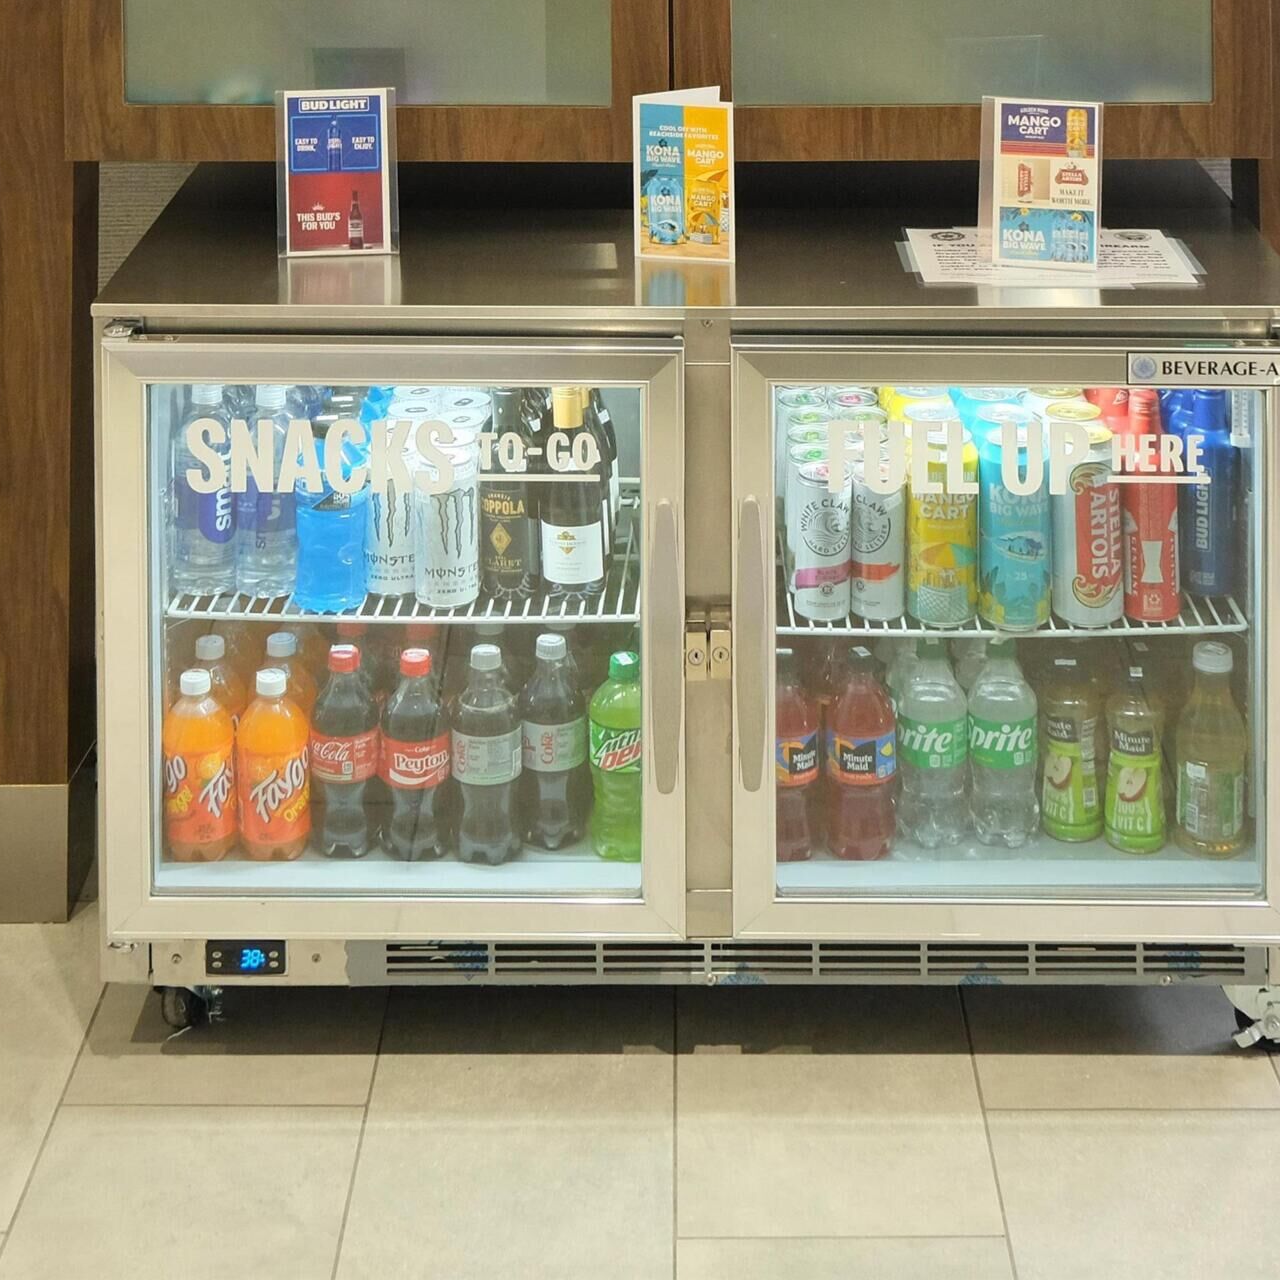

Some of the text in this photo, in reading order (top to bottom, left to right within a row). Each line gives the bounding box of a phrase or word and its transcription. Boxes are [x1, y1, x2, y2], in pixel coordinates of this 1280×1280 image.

[301, 99, 367, 111] BUD LIGHT
[1007, 114, 1062, 128] MANGO
[1019, 126, 1049, 136] CART
[687, 149, 725, 160] MANGO
[296, 213, 315, 222] THIS
[302, 221, 336, 231] FOR YOU
[1002, 229, 1046, 243] KONA
[185, 417, 601, 495] SNACKS TO-GO
[827, 419, 1206, 496] FUEL UP HERE
[855, 494, 888, 517] CLAW
[921, 504, 970, 520] CART
[800, 501, 820, 532] WHITE
[1090, 491, 1108, 580] ARTOIS
[1108, 487, 1122, 577] STELLA
[1196, 519, 1209, 550] BUD
[364, 553, 415, 566] MONSTE
[393, 750, 449, 775] Peyton
[843, 751, 873, 763] Minute
[847, 761, 869, 771] Maid
[249, 745, 309, 823] Faygo
